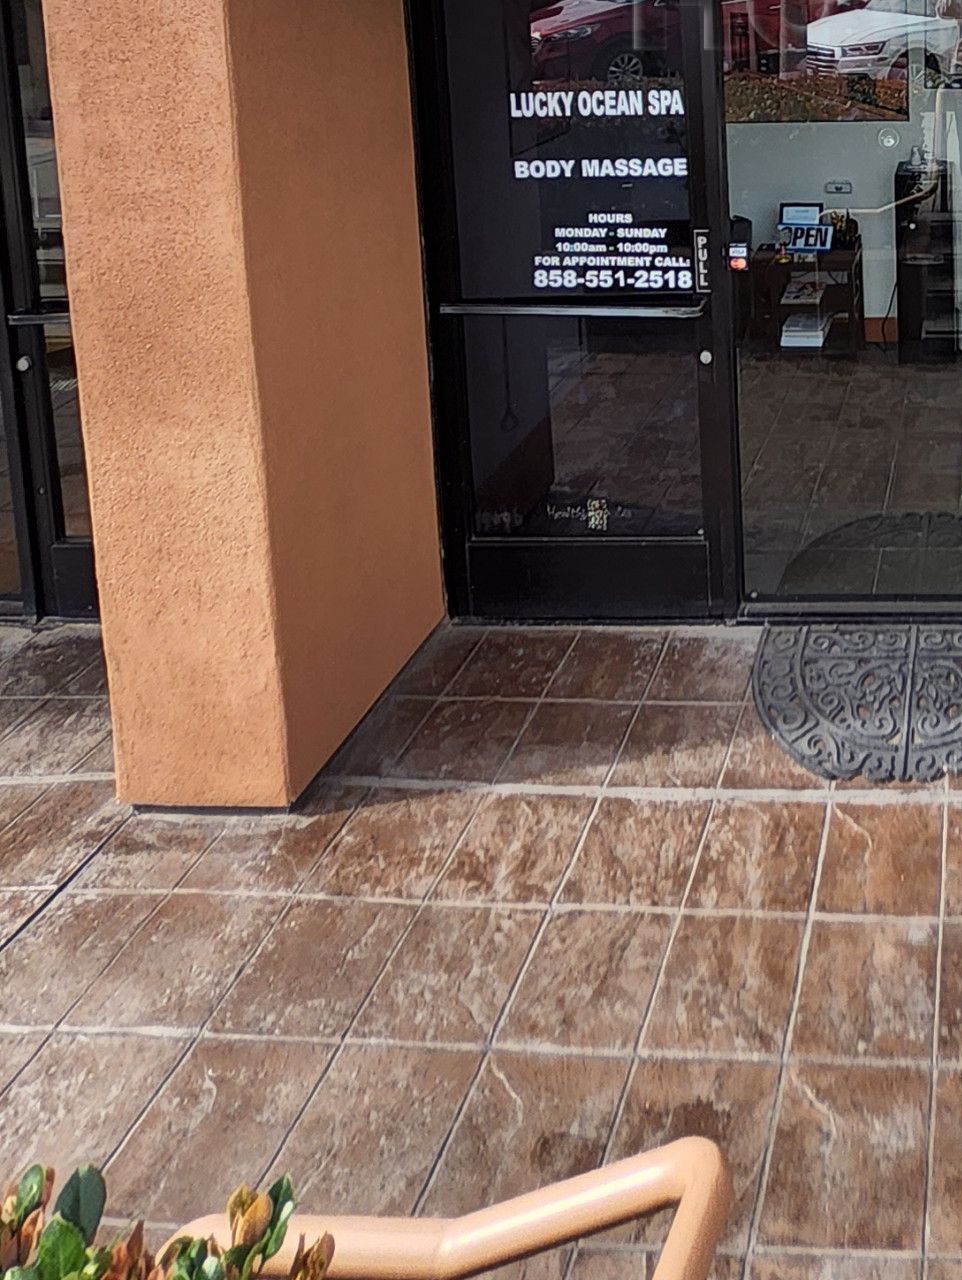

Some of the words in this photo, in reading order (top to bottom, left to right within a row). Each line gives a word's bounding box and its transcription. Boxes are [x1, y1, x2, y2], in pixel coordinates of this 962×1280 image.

[509, 91, 574, 118] LUCKY
[577, 90, 644, 117] OCEAN
[647, 89, 686, 116] SPA
[514, 160, 576, 178] BODY
[581, 158, 688, 177] MASSAGE
[588, 213, 633, 224] HOURS
[554, 227, 608, 238] MONDAY
[616, 227, 668, 238] SUNDAY
[780, 226, 830, 247] OPEN
[555, 241, 607, 252] 10:00am
[616, 241, 668, 255] 10:00pm
[533, 256, 561, 266] FOR
[562, 256, 653, 267] APPOINTMENT
[654, 256, 691, 267] CALL:
[696, 236, 709, 287] PULL
[533, 269, 693, 289] 858-551-2518
